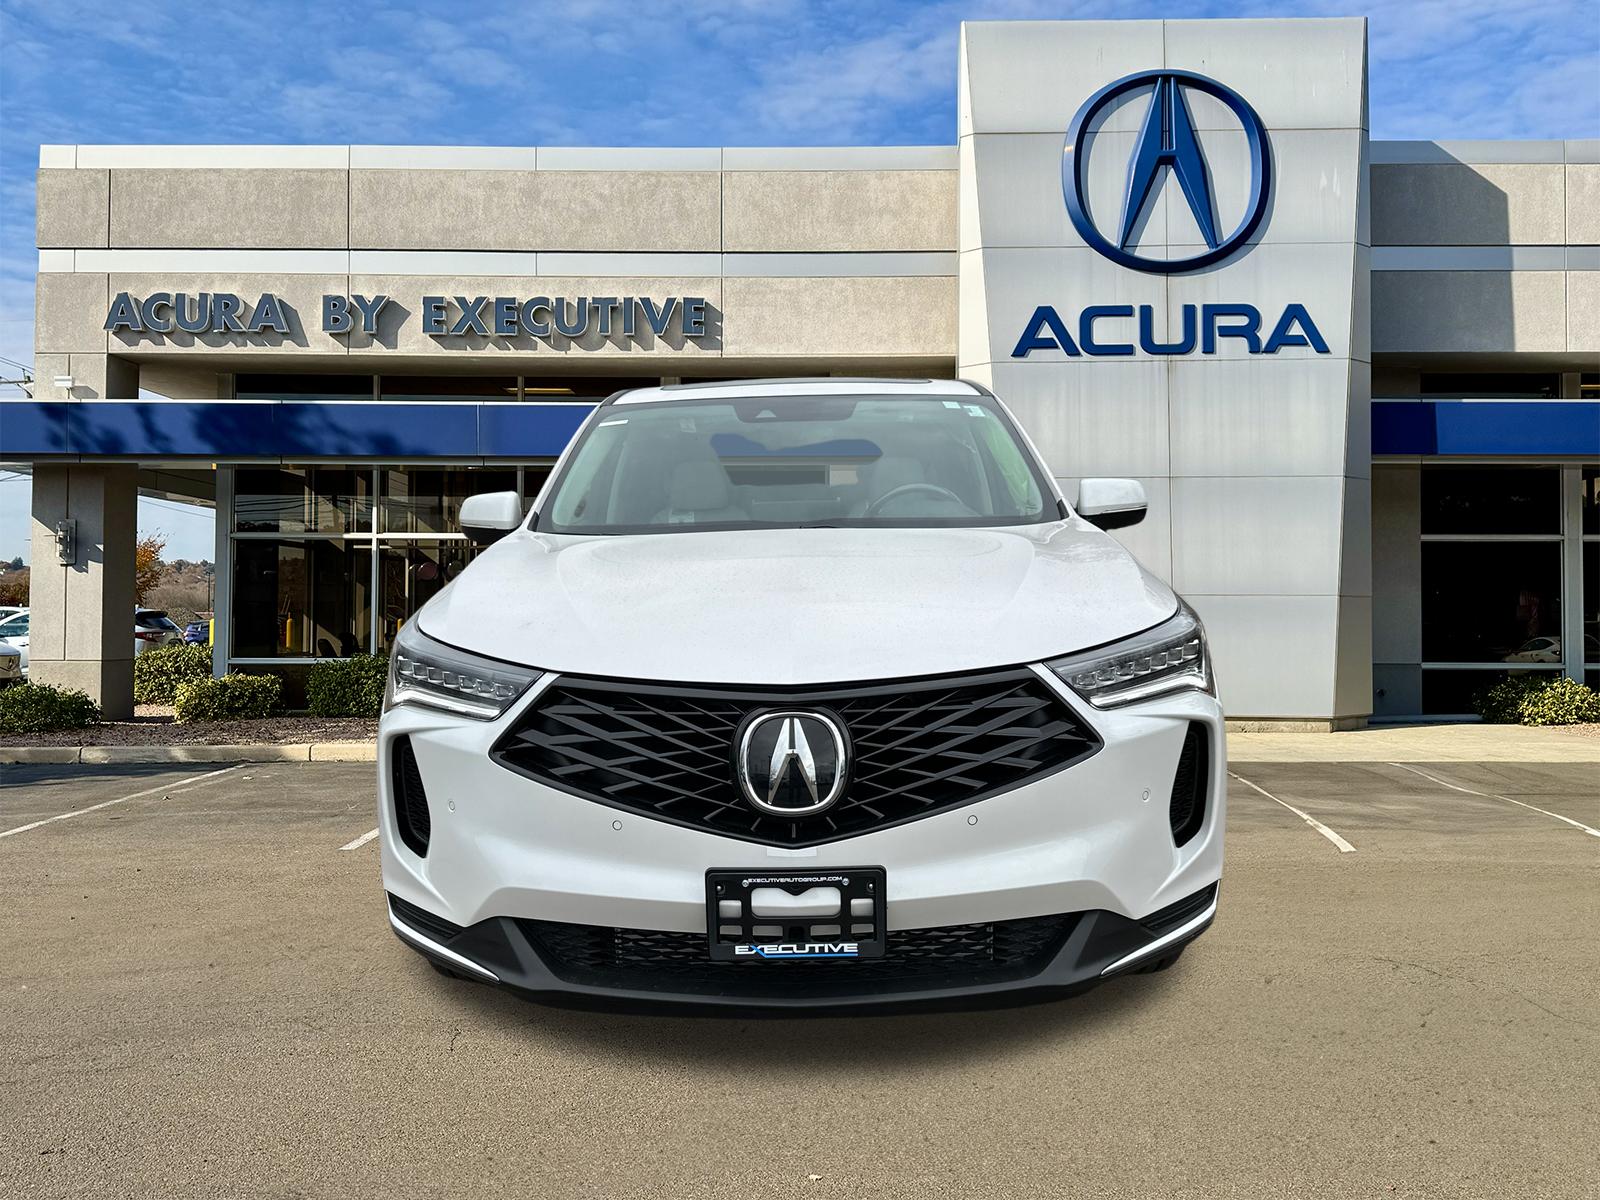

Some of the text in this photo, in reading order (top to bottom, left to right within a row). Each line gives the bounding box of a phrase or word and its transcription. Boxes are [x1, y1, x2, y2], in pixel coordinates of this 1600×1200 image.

[104, 292, 707, 337] ACURA BY EXECUTIVE
[1010, 303, 1332, 357] ACURA
[734, 943, 859, 956] EXECUTIVE
